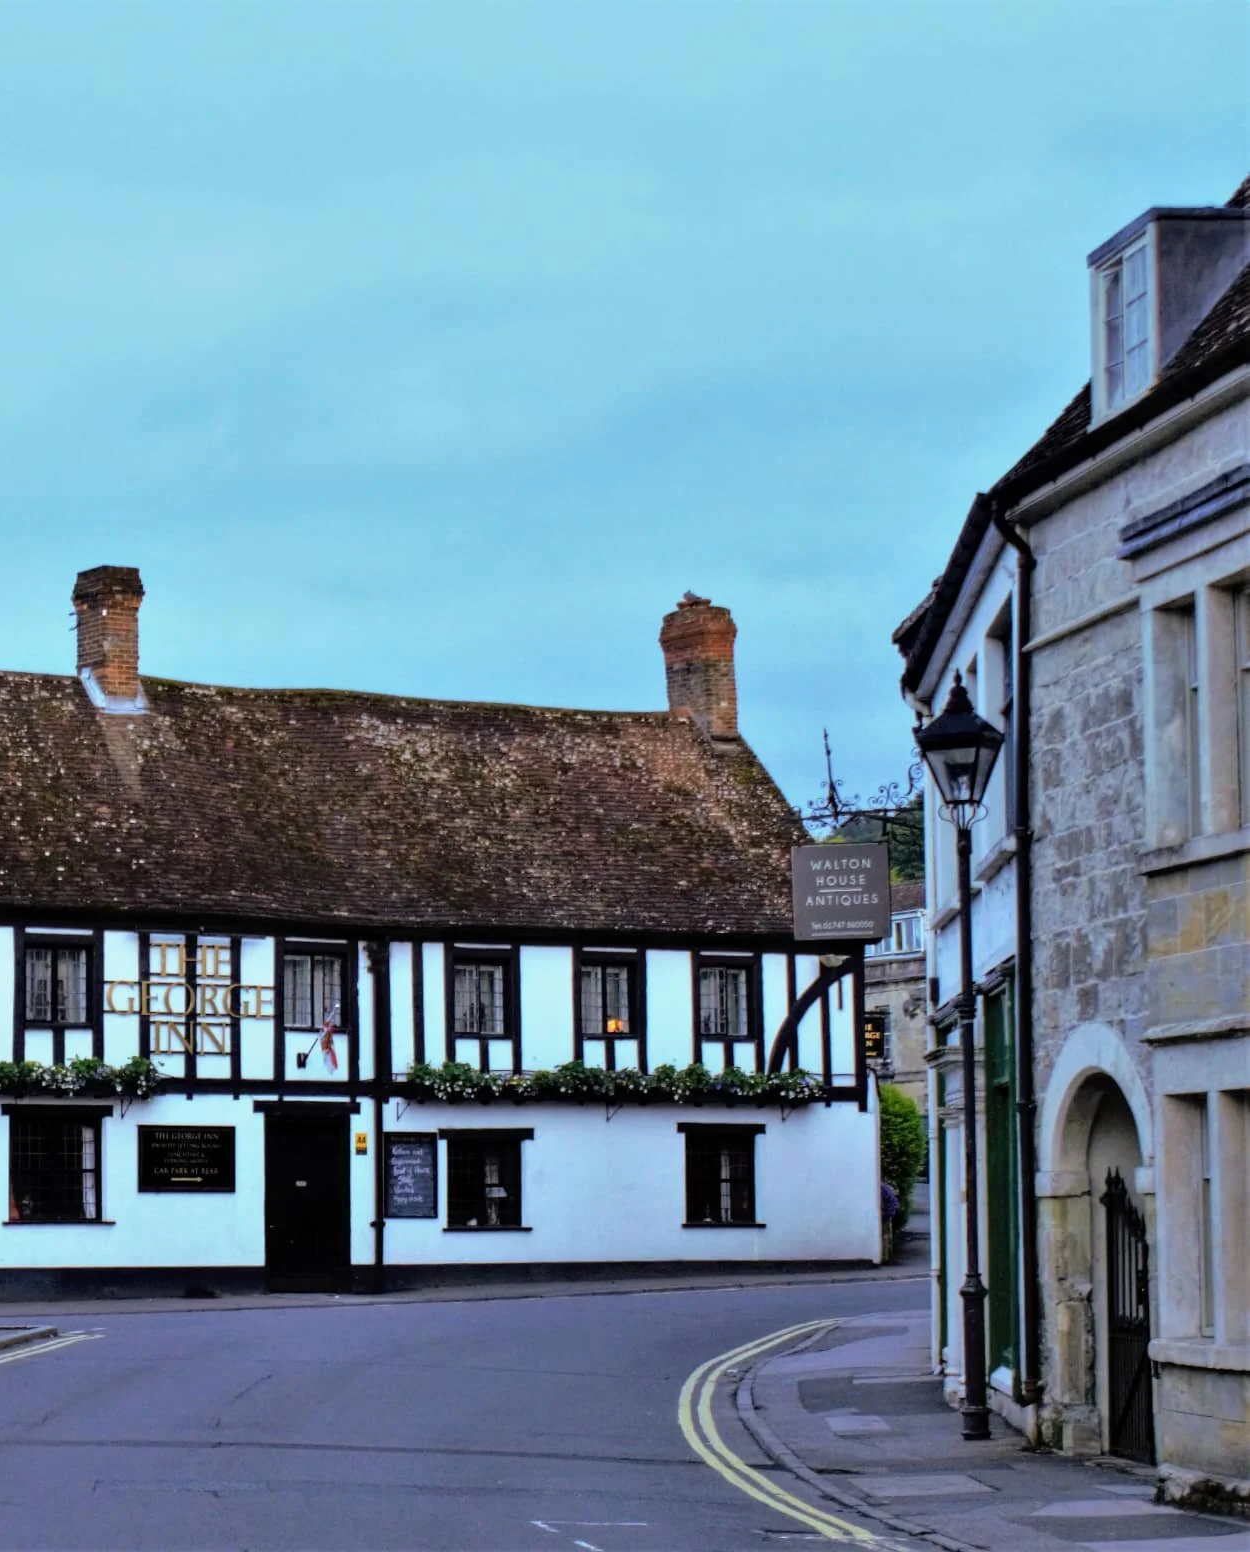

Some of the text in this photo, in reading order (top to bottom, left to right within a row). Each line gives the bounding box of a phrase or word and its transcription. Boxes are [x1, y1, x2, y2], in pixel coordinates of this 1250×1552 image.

[809, 857, 871, 871] WALTON
[815, 874, 866, 887] HOUSE
[805, 893, 879, 907] ANTIQUES
[154, 943, 230, 977] THE
[106, 980, 274, 1019] GEORGE
[153, 1020, 228, 1056] INN
[155, 1132, 219, 1141] THE GEORGE INN
[153, 1167, 219, 1175] CAR PARK AT REAR
